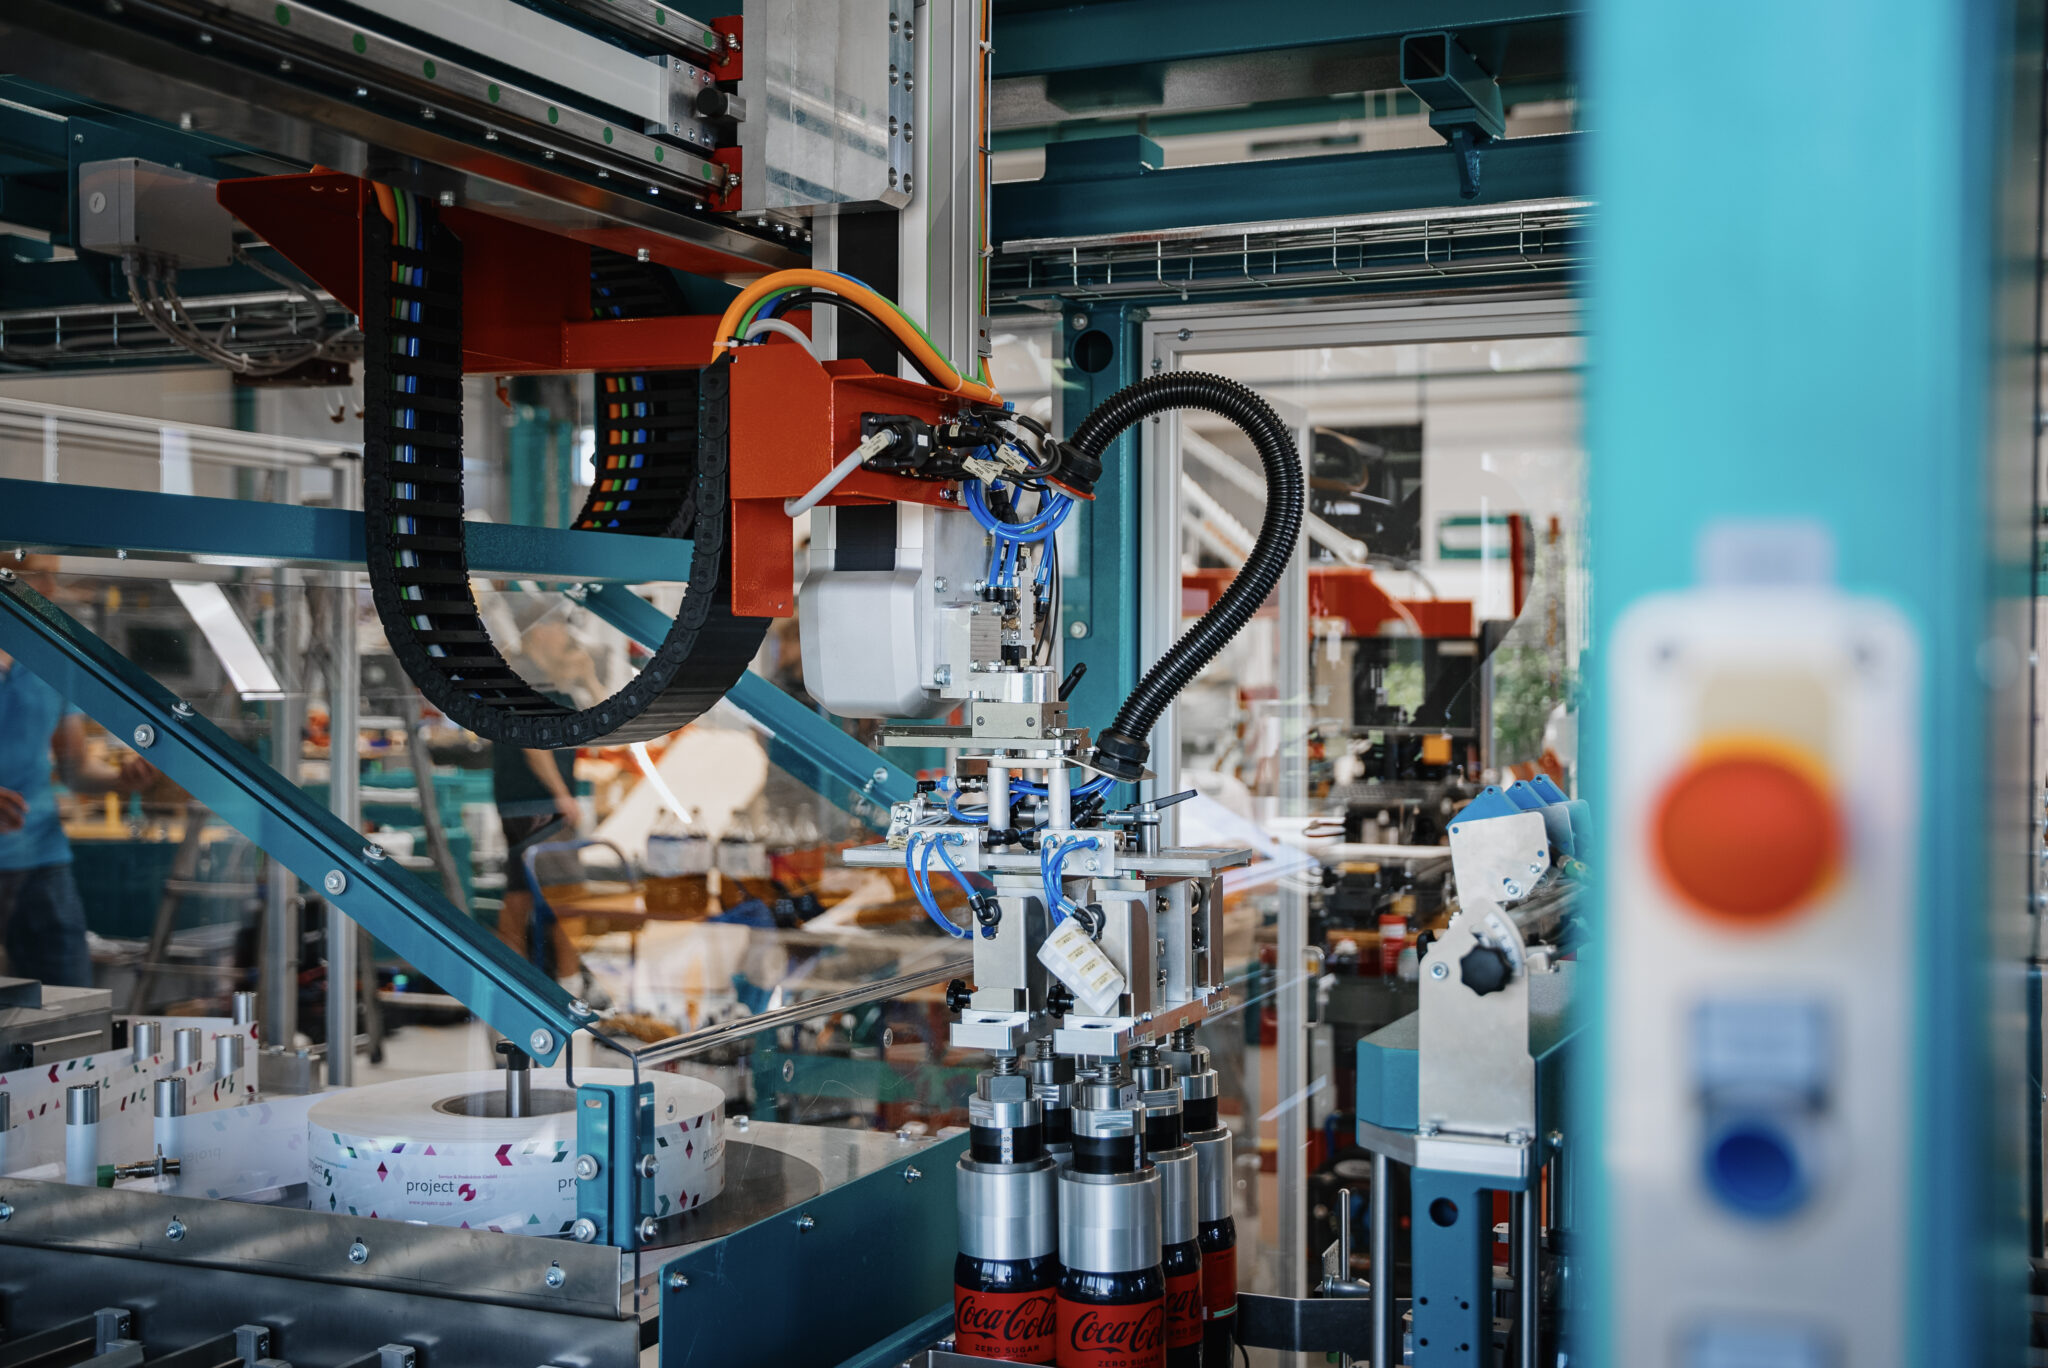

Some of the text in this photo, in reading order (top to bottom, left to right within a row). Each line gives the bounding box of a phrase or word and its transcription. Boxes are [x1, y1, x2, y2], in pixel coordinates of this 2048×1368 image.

[406, 1179, 455, 1196] project
[958, 1293, 1056, 1341] Coca-Cola
[975, 1344, 1039, 1354] ZERO SUGAR
